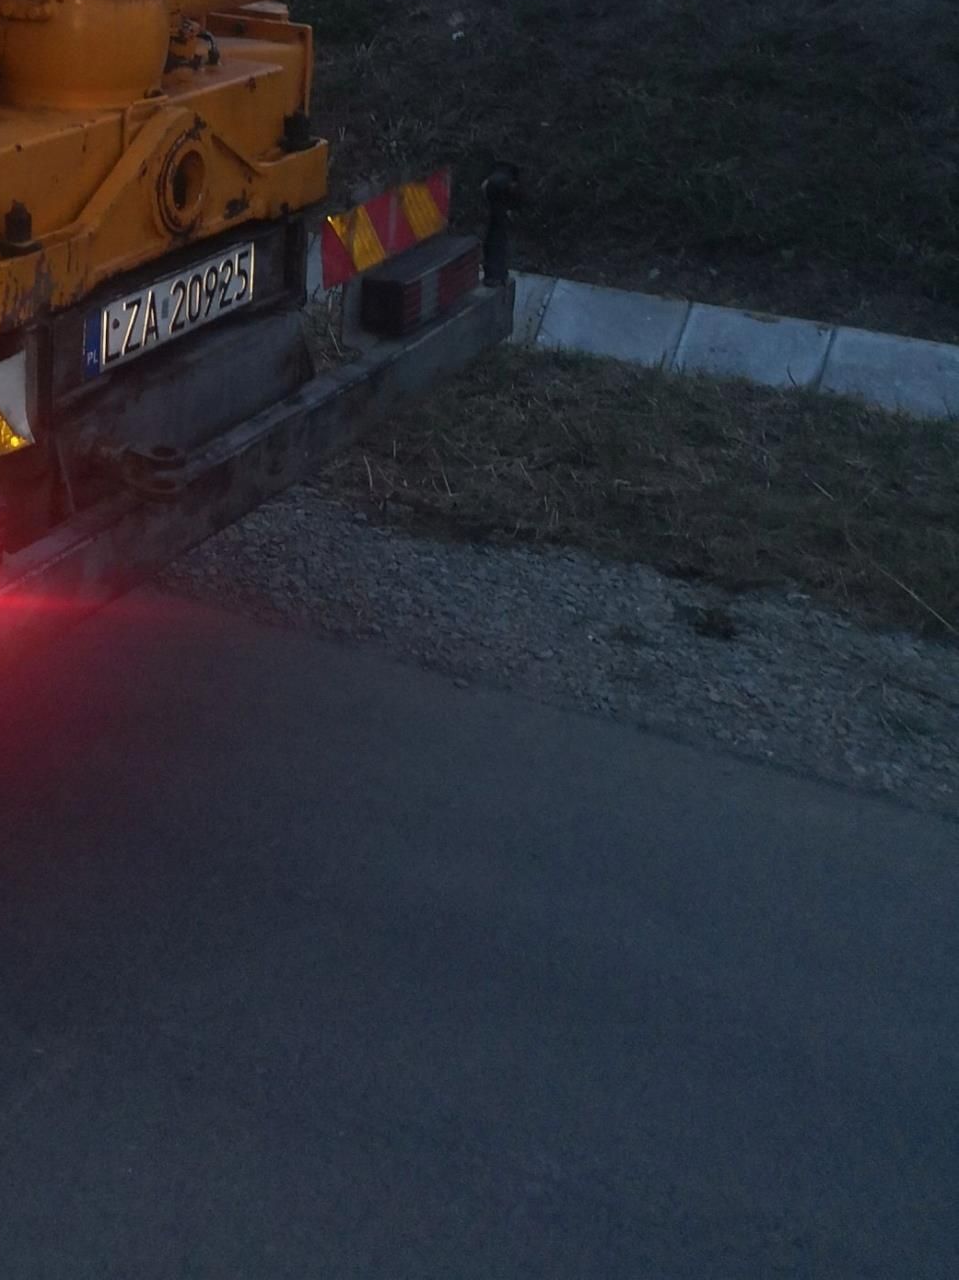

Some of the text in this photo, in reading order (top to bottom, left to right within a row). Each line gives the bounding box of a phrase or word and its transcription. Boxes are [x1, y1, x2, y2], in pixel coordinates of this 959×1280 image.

[102, 251, 248, 365] LZA 20925
[87, 351, 98, 365] PL
